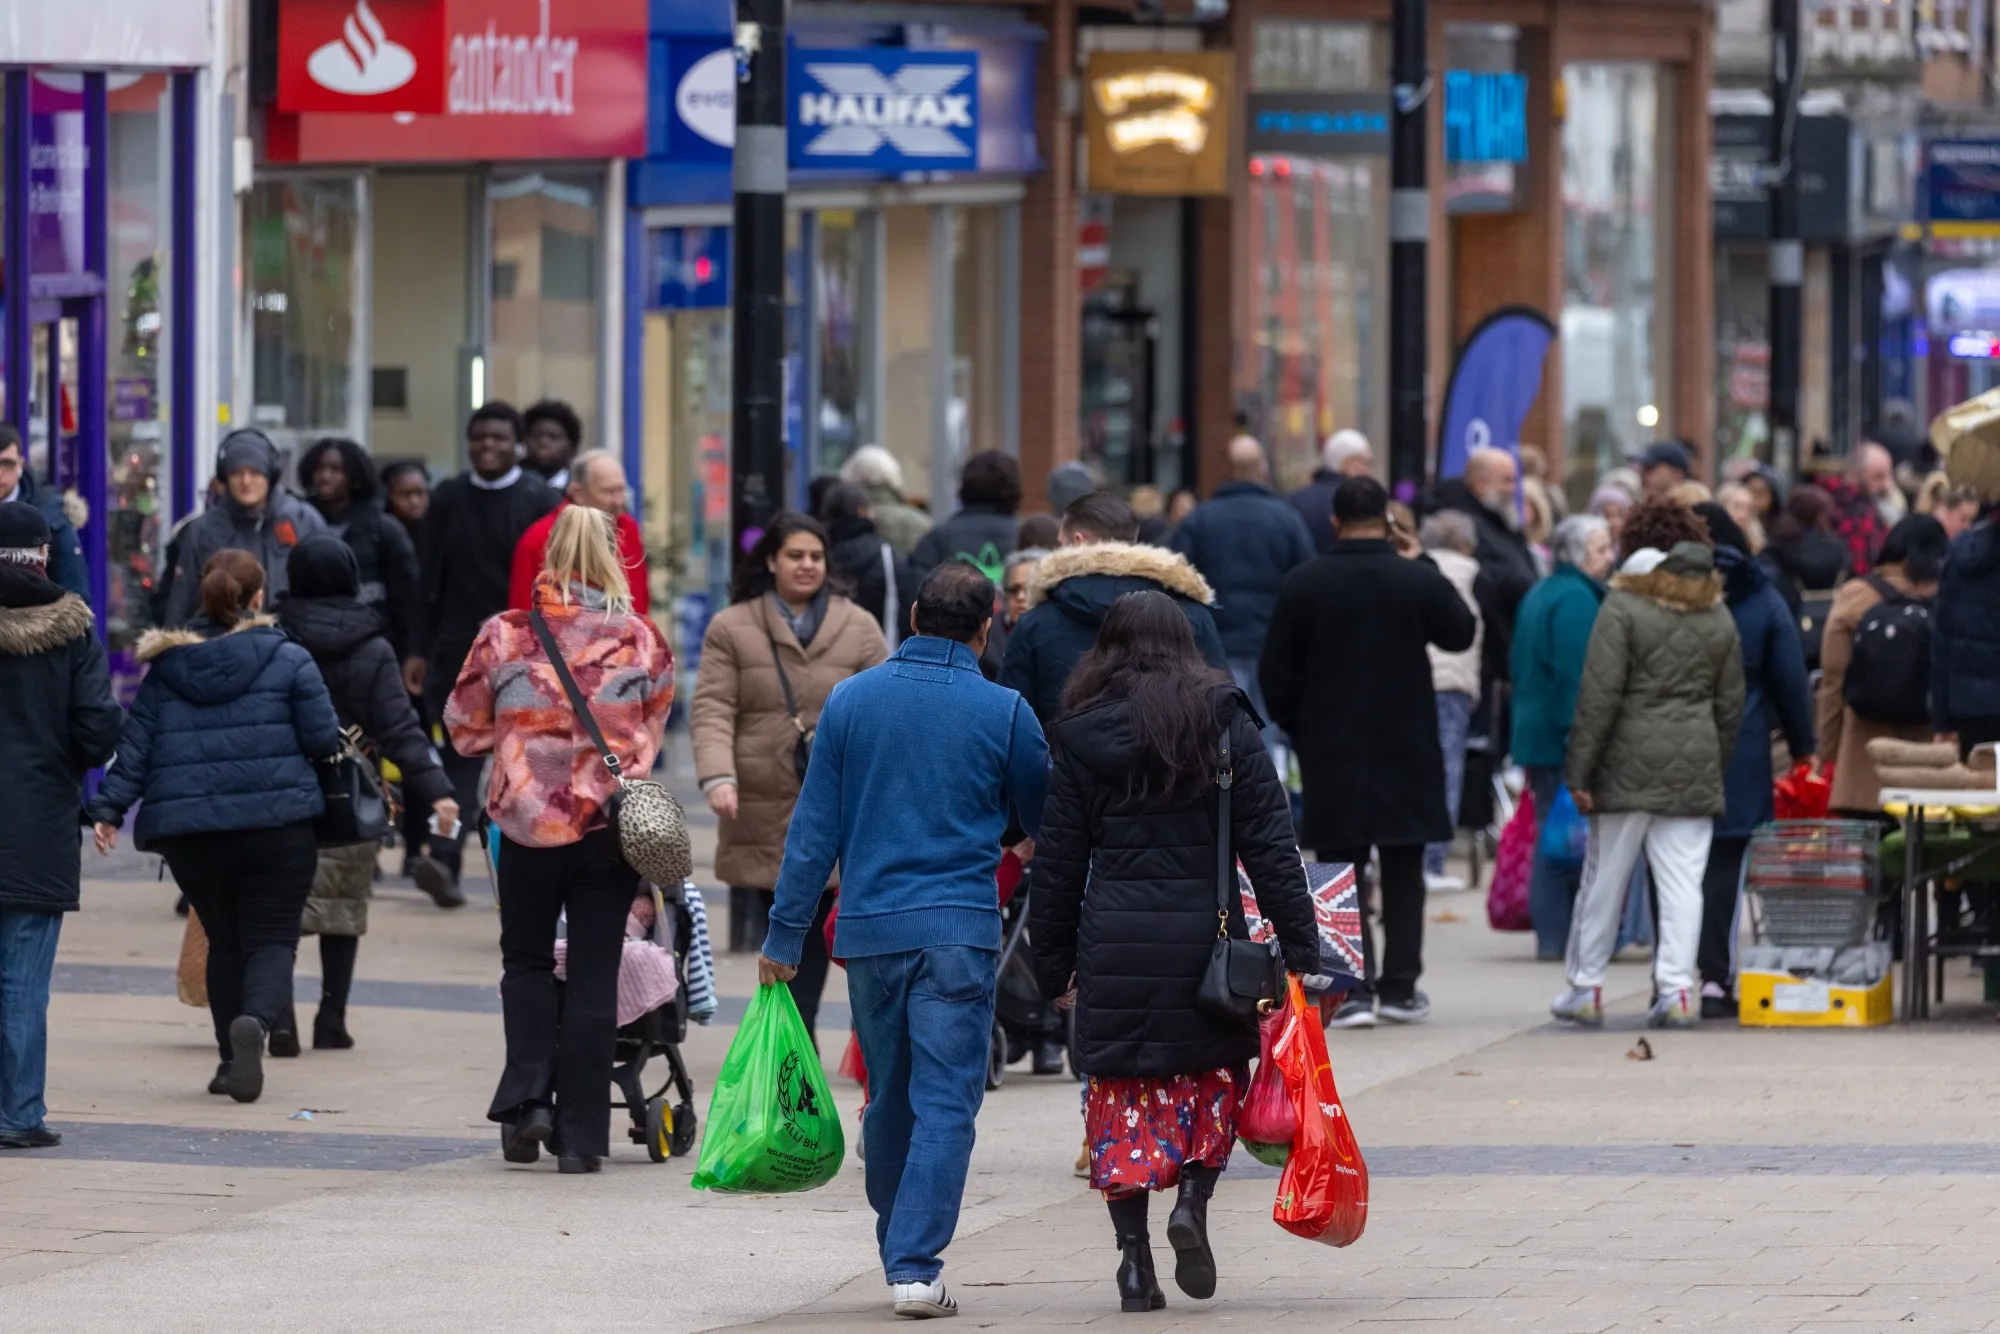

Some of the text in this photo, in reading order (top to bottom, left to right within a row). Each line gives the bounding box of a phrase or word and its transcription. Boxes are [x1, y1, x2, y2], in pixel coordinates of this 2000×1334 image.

[448, 0, 578, 114] antander
[799, 91, 973, 128] HALIFAX
[783, 1122, 804, 1143] ALLI
